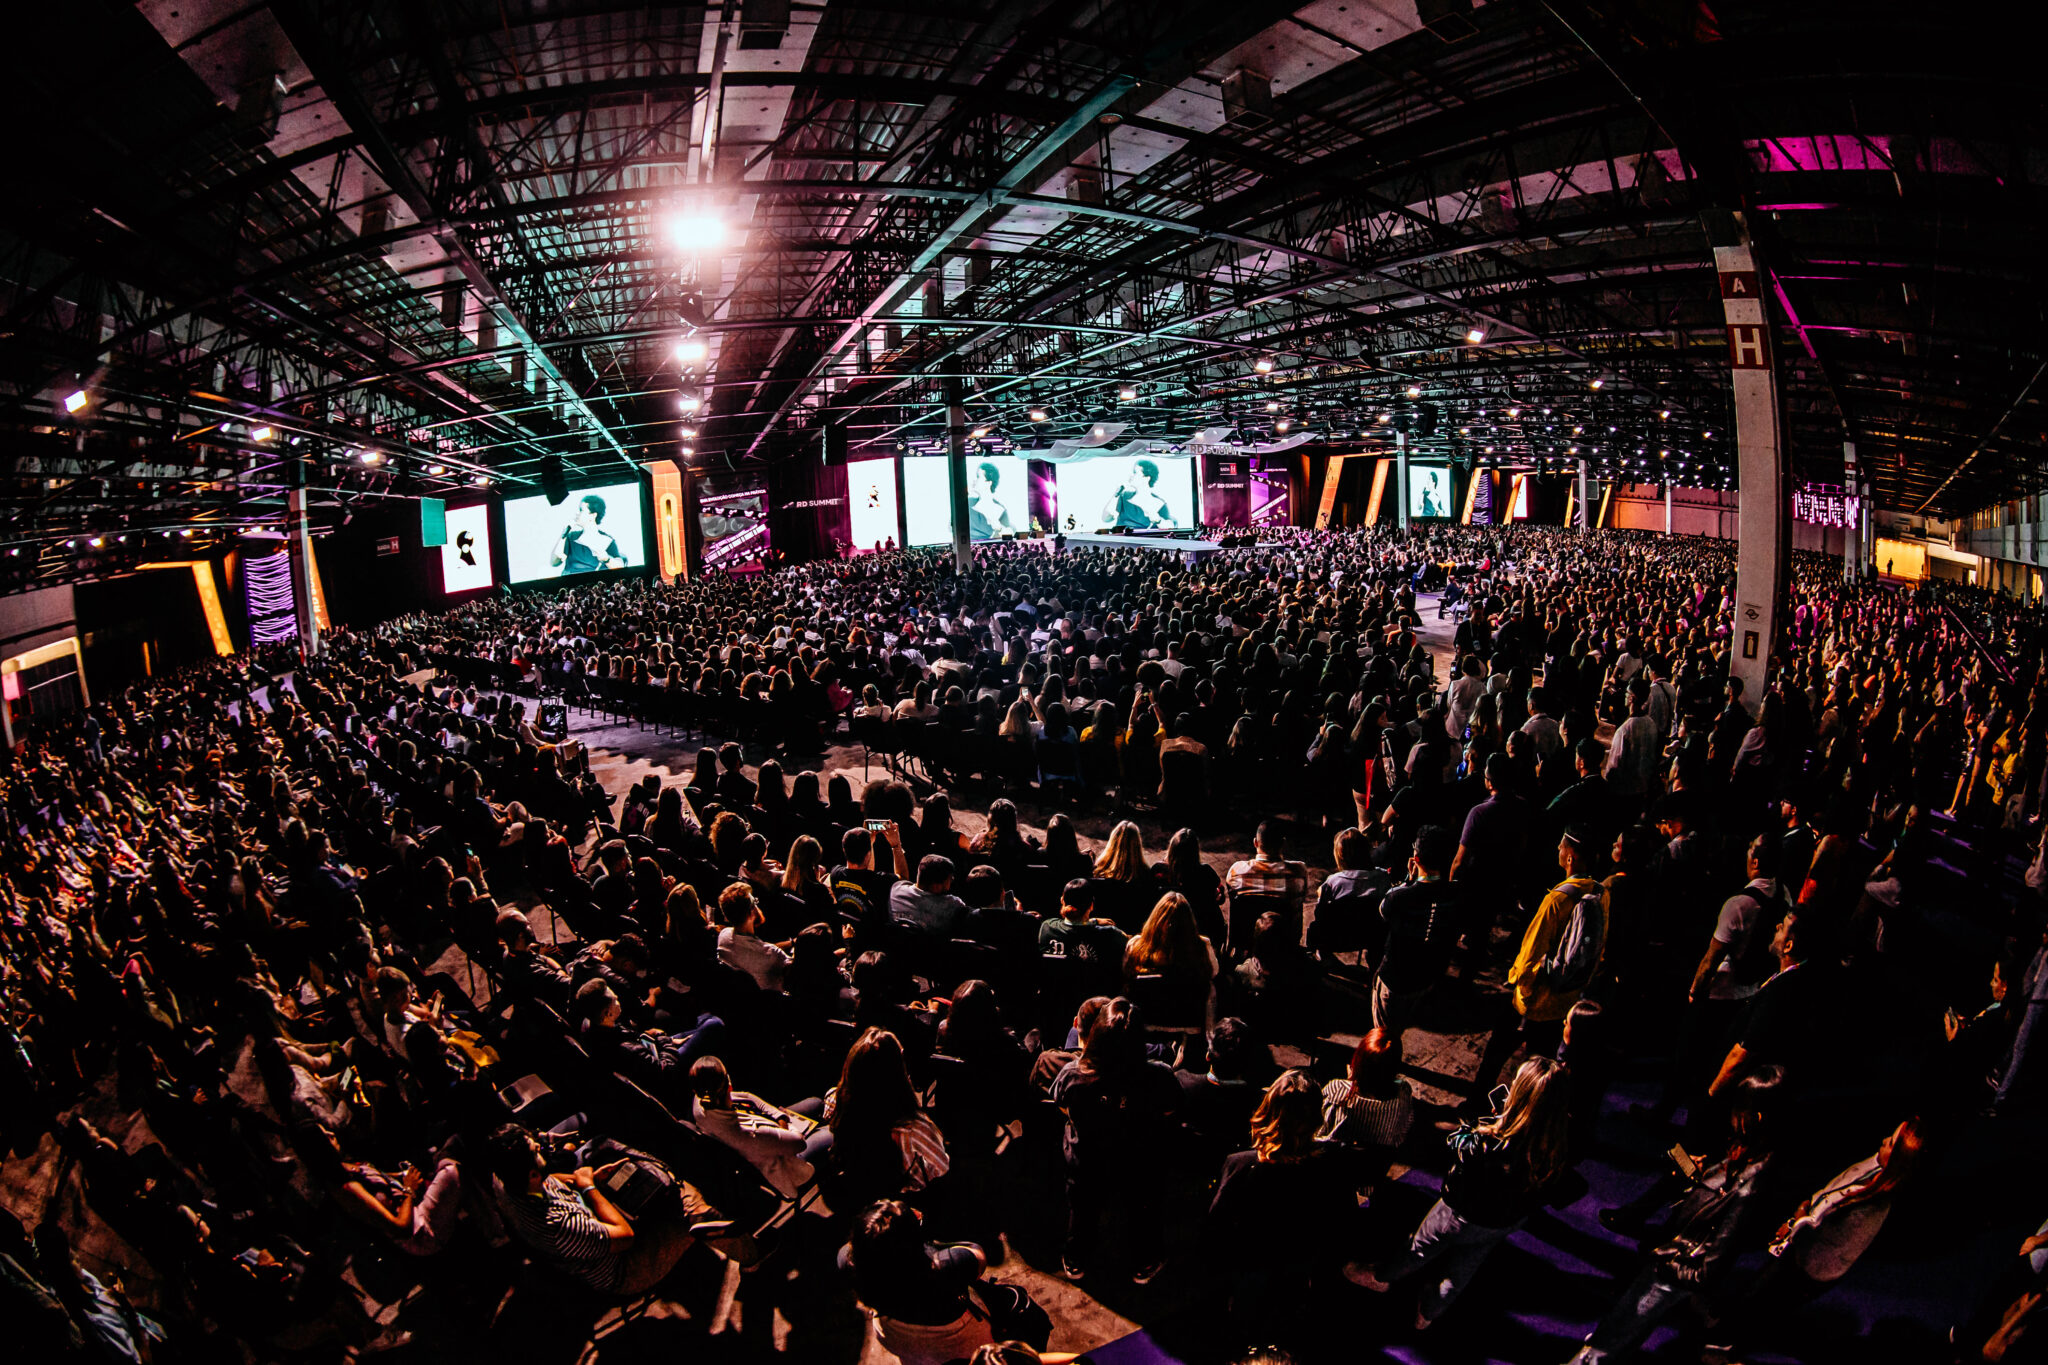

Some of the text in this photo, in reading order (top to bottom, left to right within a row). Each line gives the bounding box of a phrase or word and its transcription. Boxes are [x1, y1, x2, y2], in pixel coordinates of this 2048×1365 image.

[1733, 277, 1746, 293] A
[1733, 327, 1764, 366] H
[1190, 445, 1204, 454] RD
[809, 499, 838, 507] SUMMIT
[391, 540, 399, 550] H
